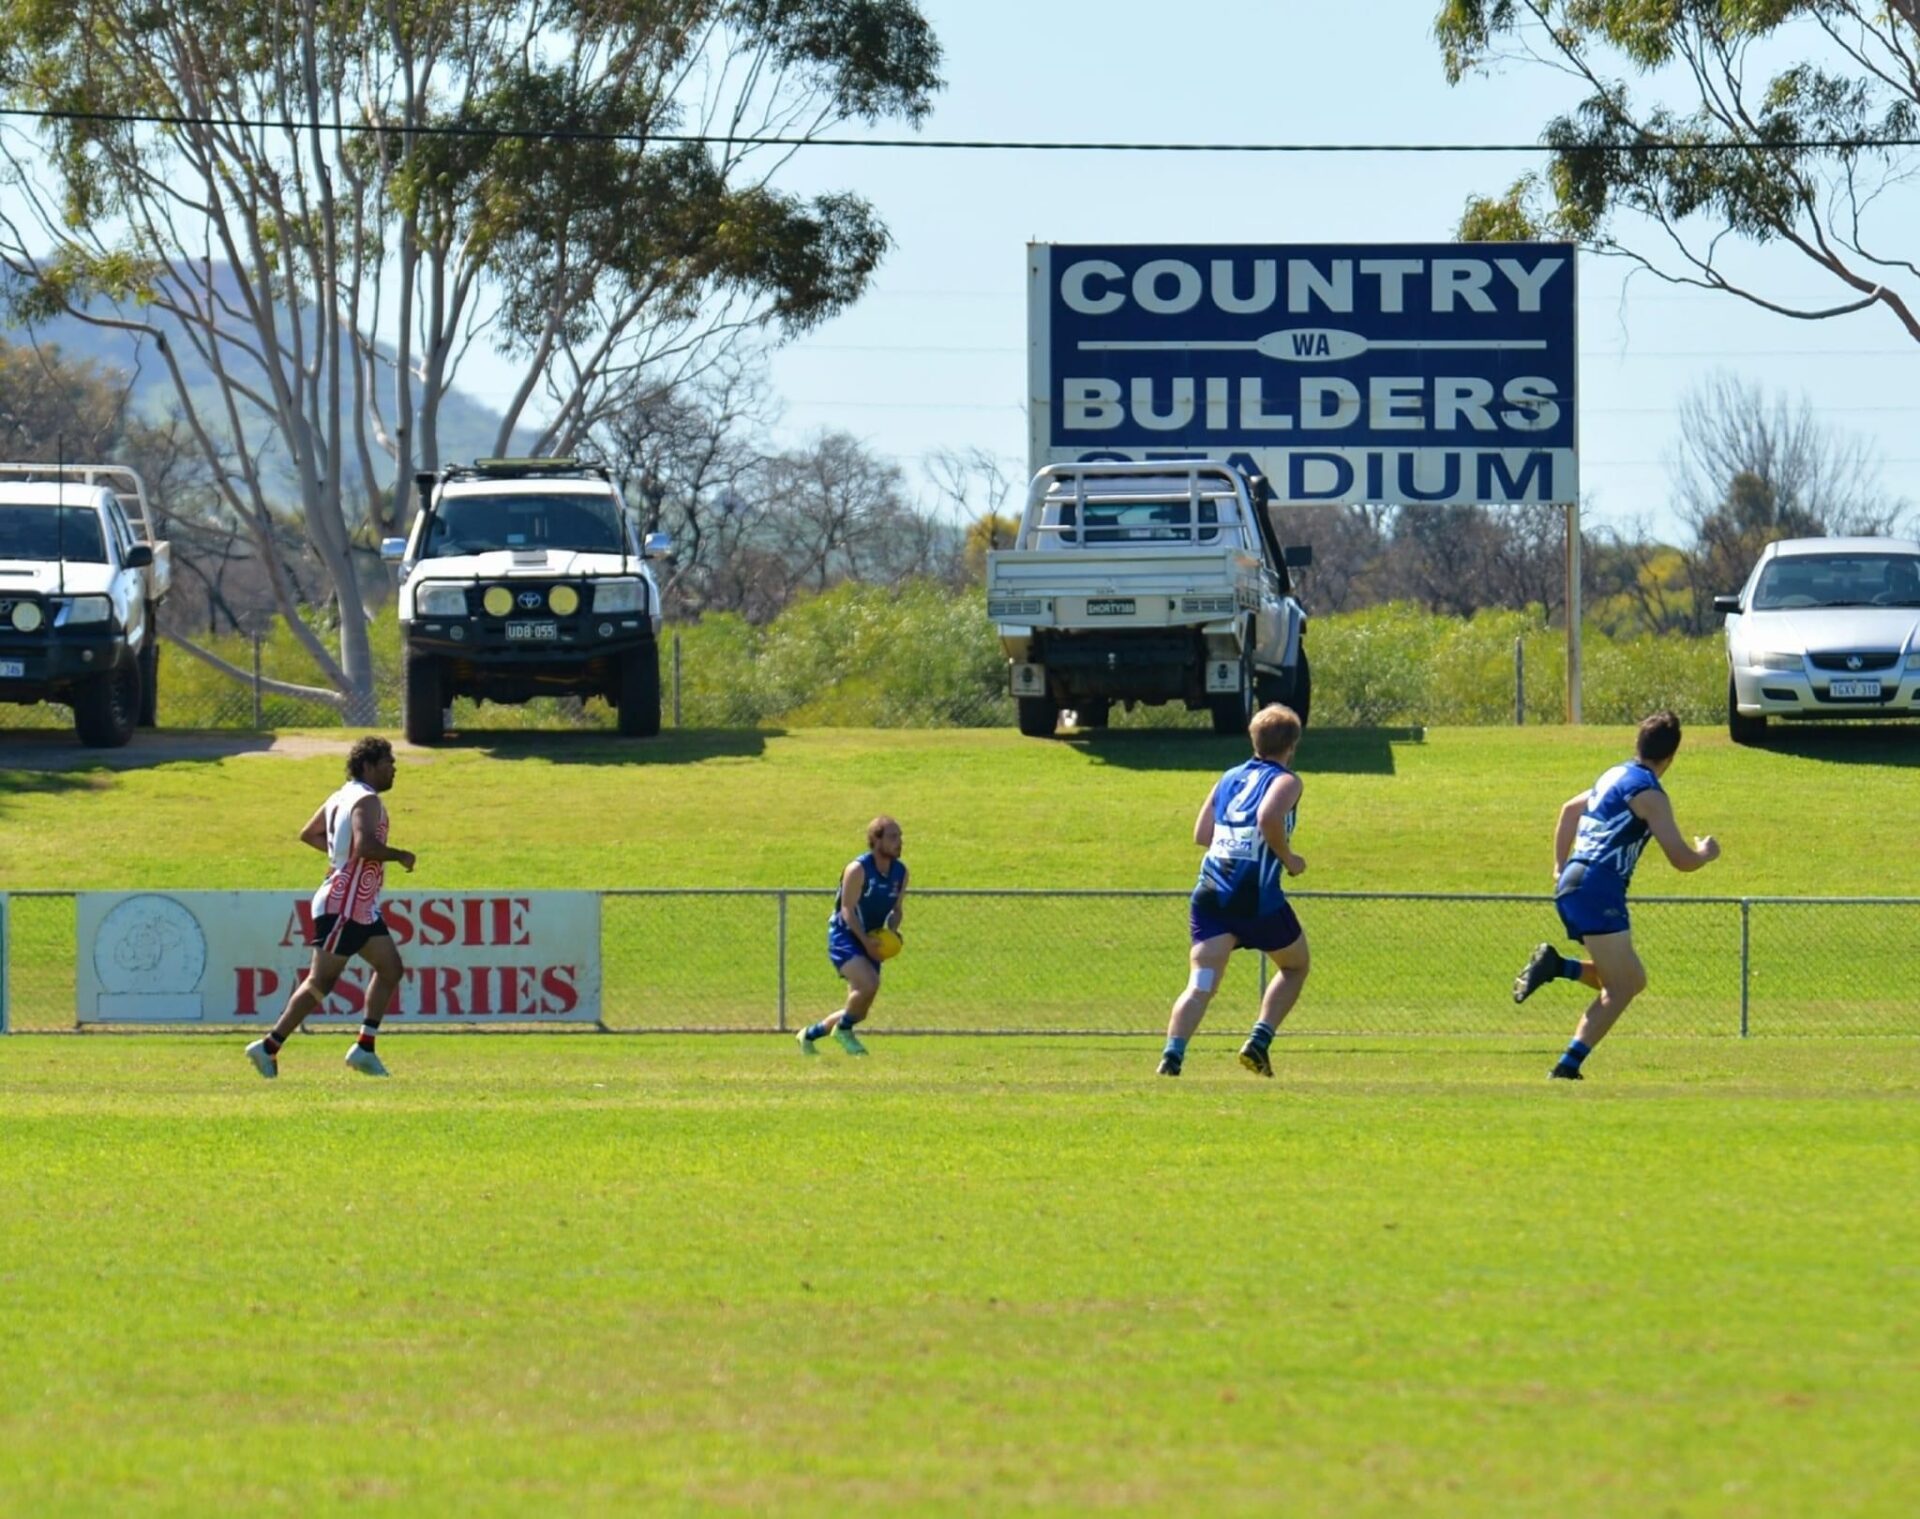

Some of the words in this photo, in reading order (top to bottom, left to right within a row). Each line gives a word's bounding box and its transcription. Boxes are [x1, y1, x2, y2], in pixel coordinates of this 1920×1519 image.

[1060, 258, 1564, 315] COUNTRY
[1292, 333, 1331, 357] WA
[1062, 376, 1561, 430] BUILDERS
[1077, 450, 1554, 501] ADIUM
[280, 898, 530, 946] ASSIE
